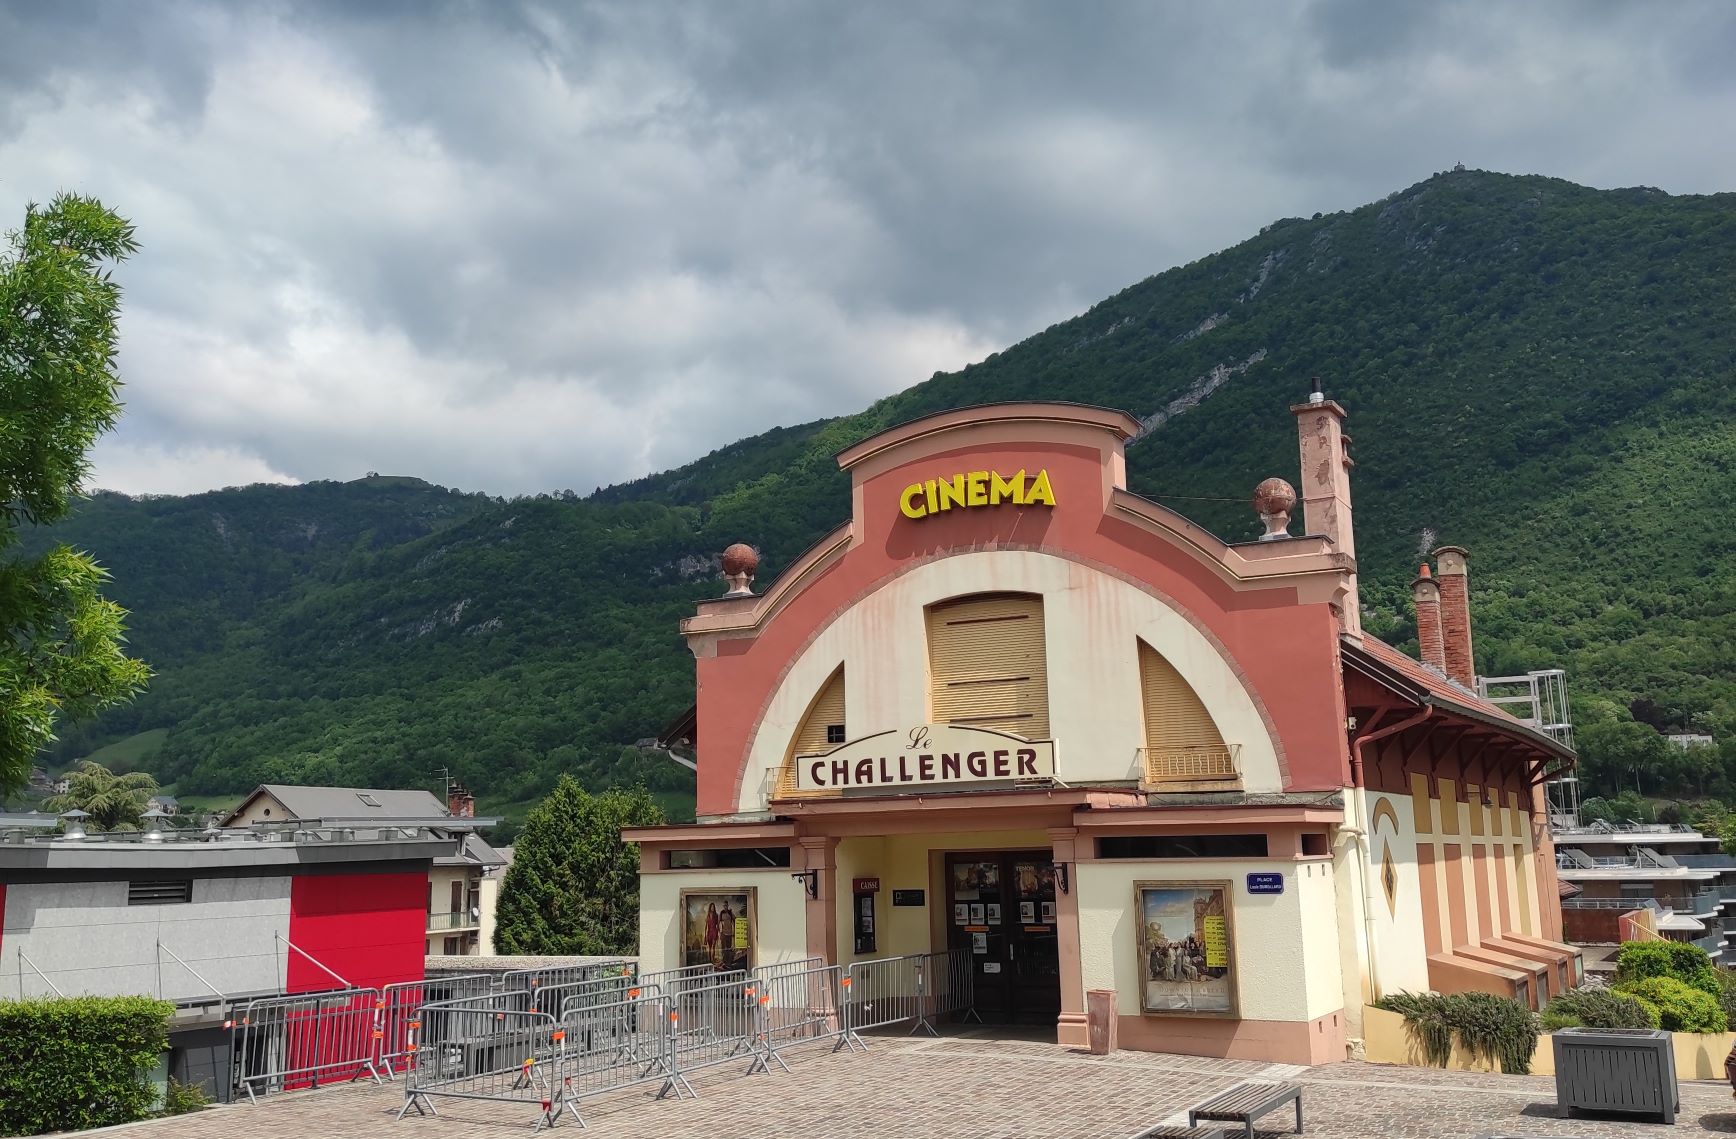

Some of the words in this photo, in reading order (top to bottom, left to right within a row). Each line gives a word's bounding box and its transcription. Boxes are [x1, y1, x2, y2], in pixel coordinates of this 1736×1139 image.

[899, 468, 1057, 520] CINEMA
[906, 726, 932, 751] Le
[811, 748, 1039, 787] CHALLENGER
[860, 881, 878, 889] CAISSE
